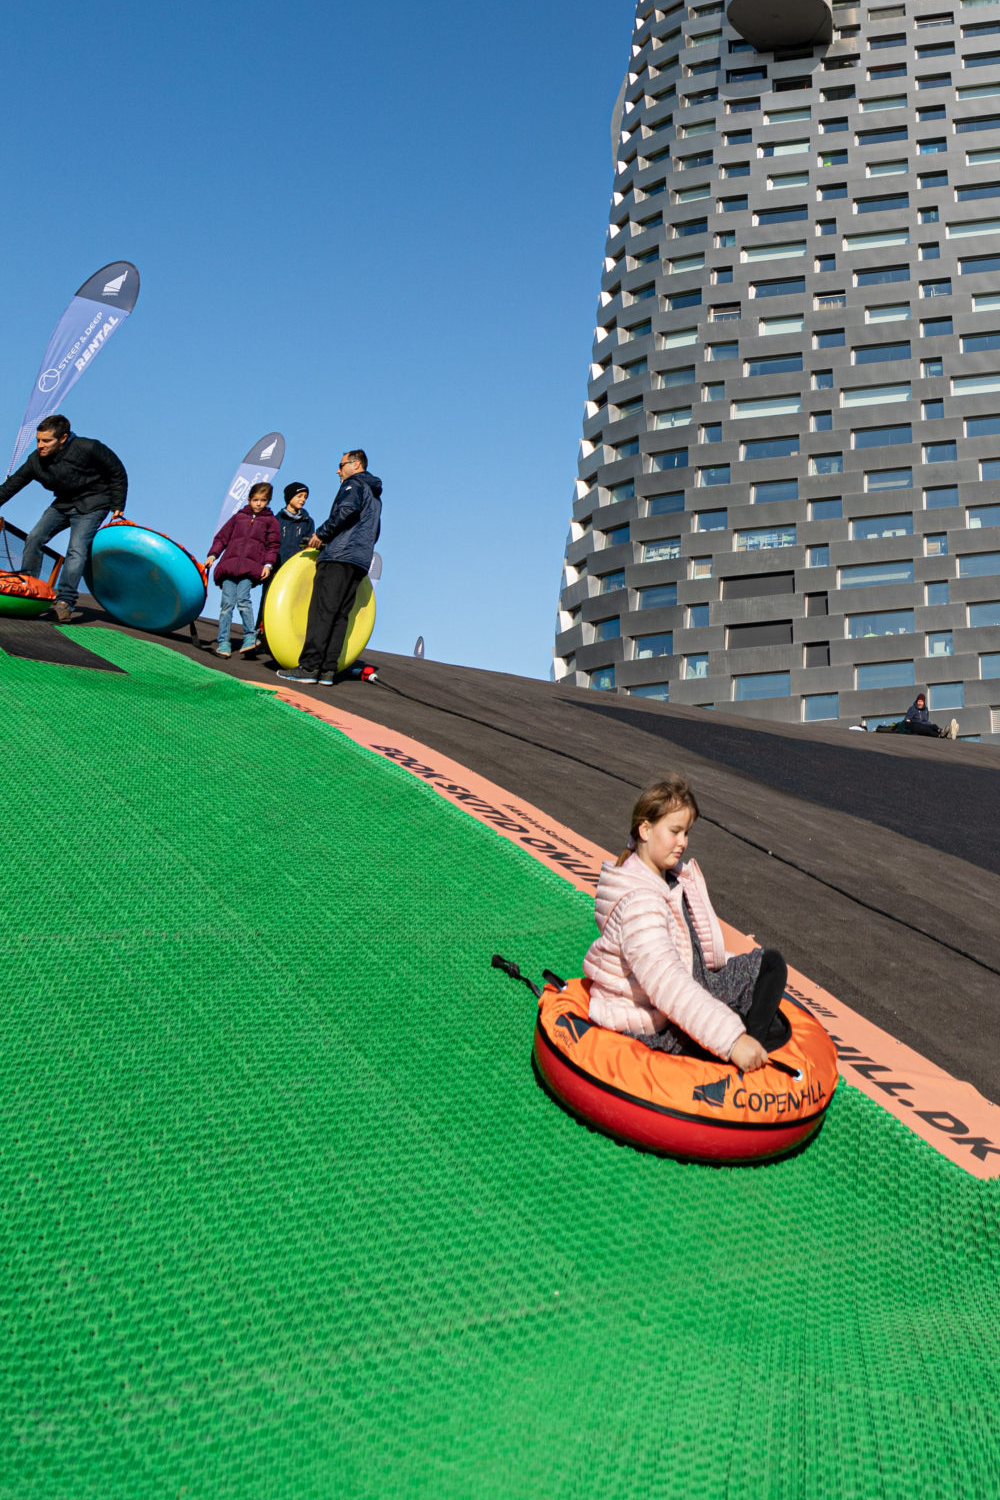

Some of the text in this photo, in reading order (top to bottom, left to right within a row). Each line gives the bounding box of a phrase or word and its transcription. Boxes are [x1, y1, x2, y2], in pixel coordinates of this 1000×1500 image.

[58, 342, 81, 370] STEEP
[85, 311, 103, 336] DEEP
[74, 316, 119, 372] RENTAL
[369, 744, 600, 889] BOOK SKITID ONLI
